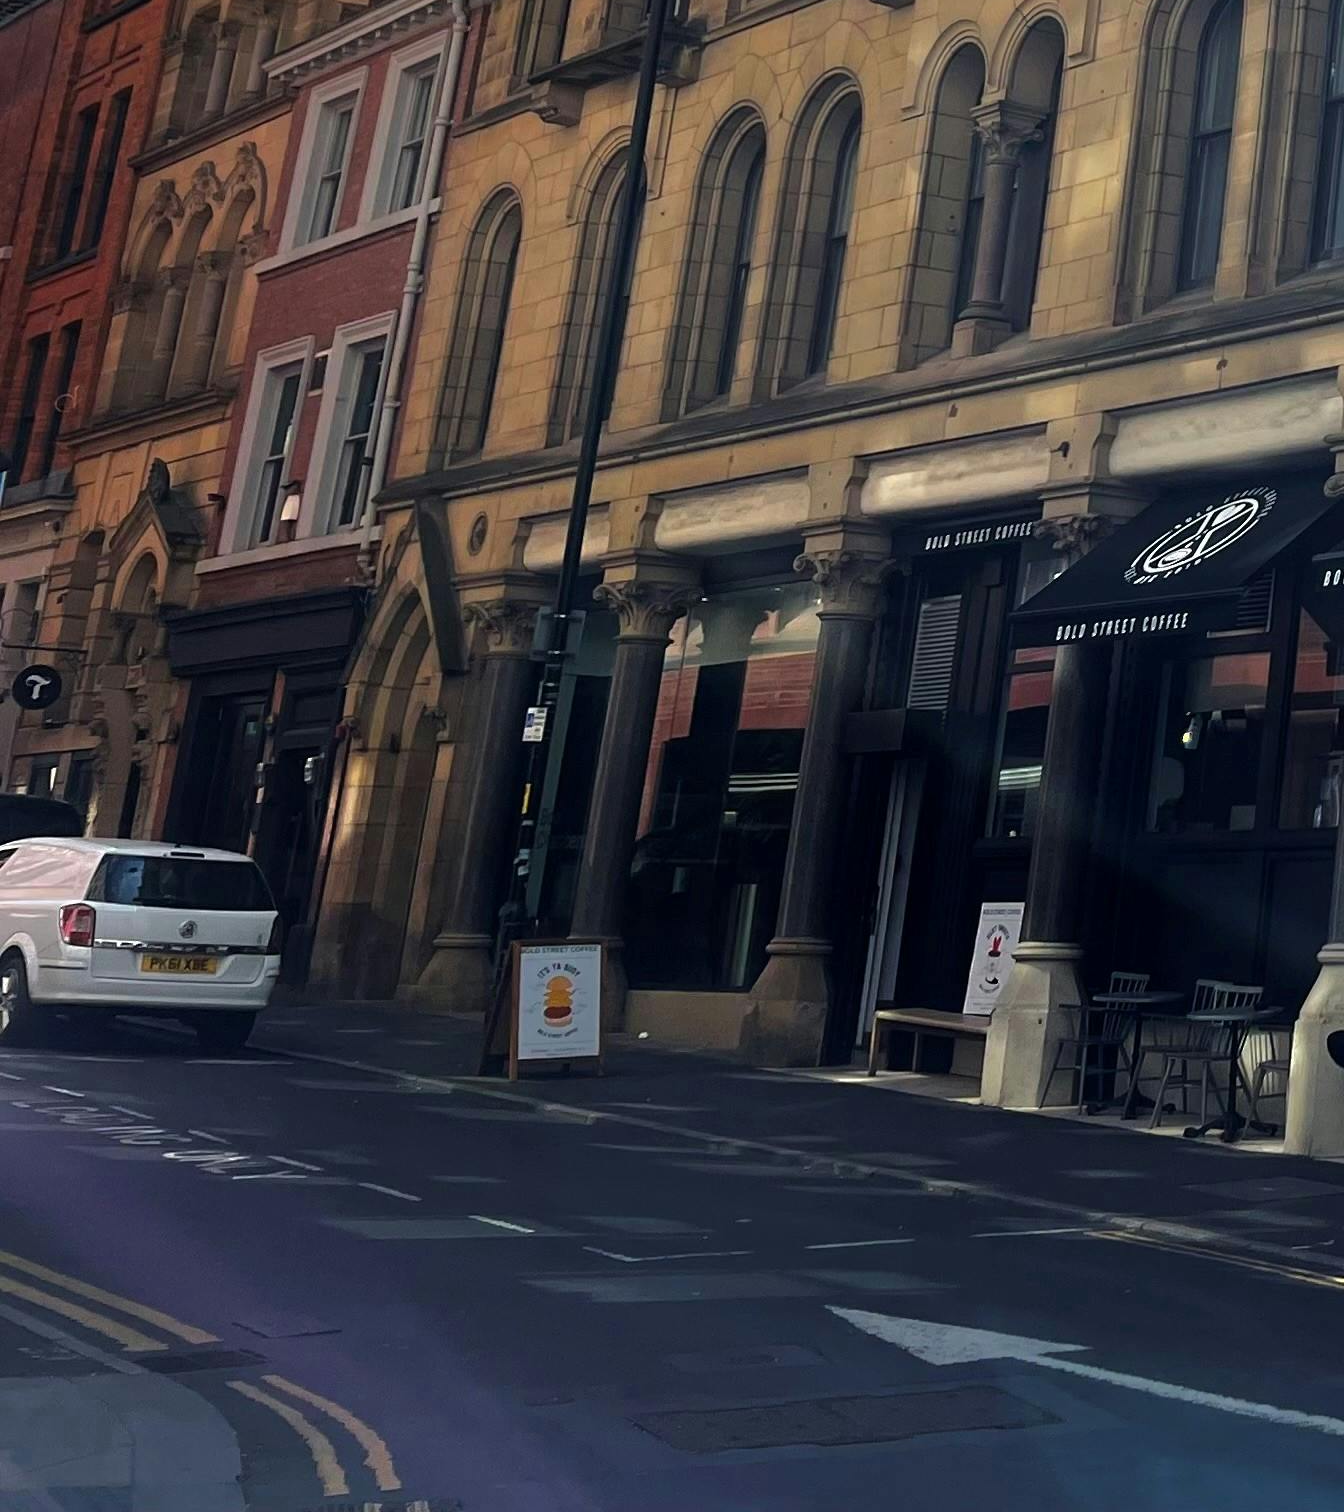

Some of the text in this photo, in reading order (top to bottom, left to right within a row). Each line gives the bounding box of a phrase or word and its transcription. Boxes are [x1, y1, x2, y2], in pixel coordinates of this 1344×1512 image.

[925, 521, 1034, 551] BOLD STREET COFFEE
[1056, 612, 1190, 642] BOLD STREET COFFEE
